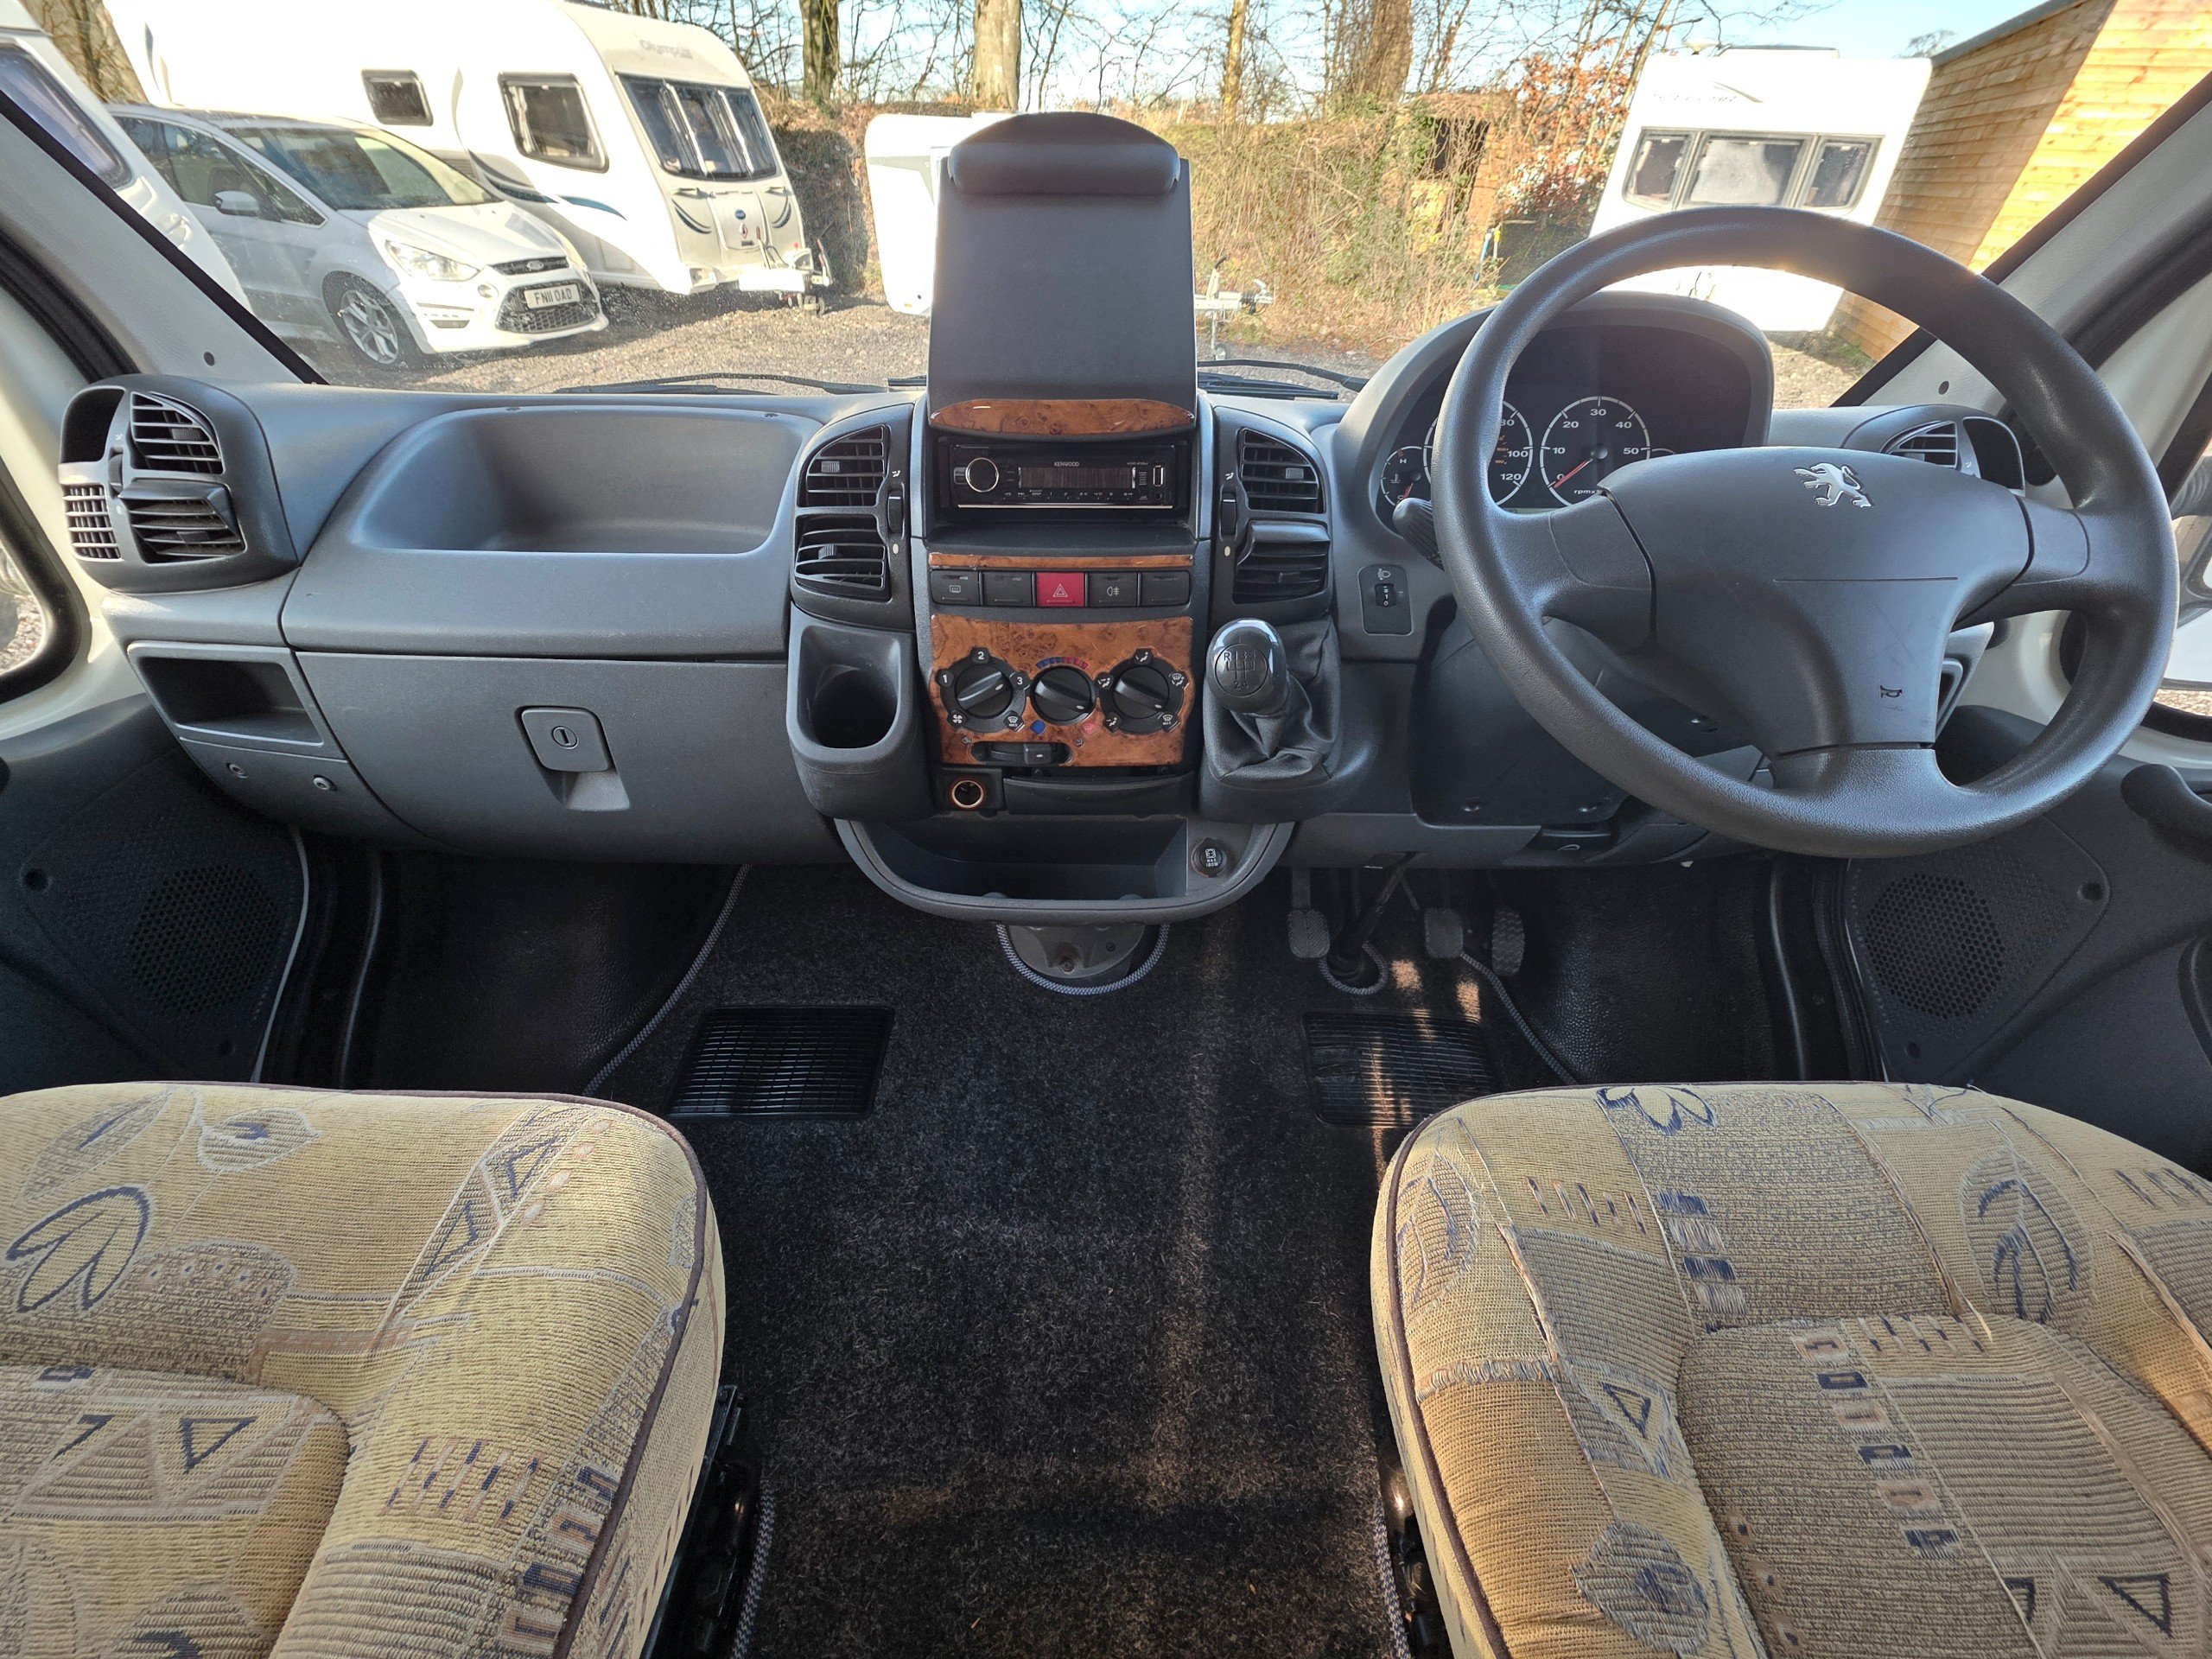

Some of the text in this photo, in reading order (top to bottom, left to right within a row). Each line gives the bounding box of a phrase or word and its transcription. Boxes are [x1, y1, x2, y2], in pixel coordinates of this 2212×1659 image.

[534, 290, 553, 305] FN11
[977, 651, 984, 660] 2
[1224, 652, 1231, 661] R
[942, 674, 948, 683] 1
[1016, 677, 1023, 685] 3
